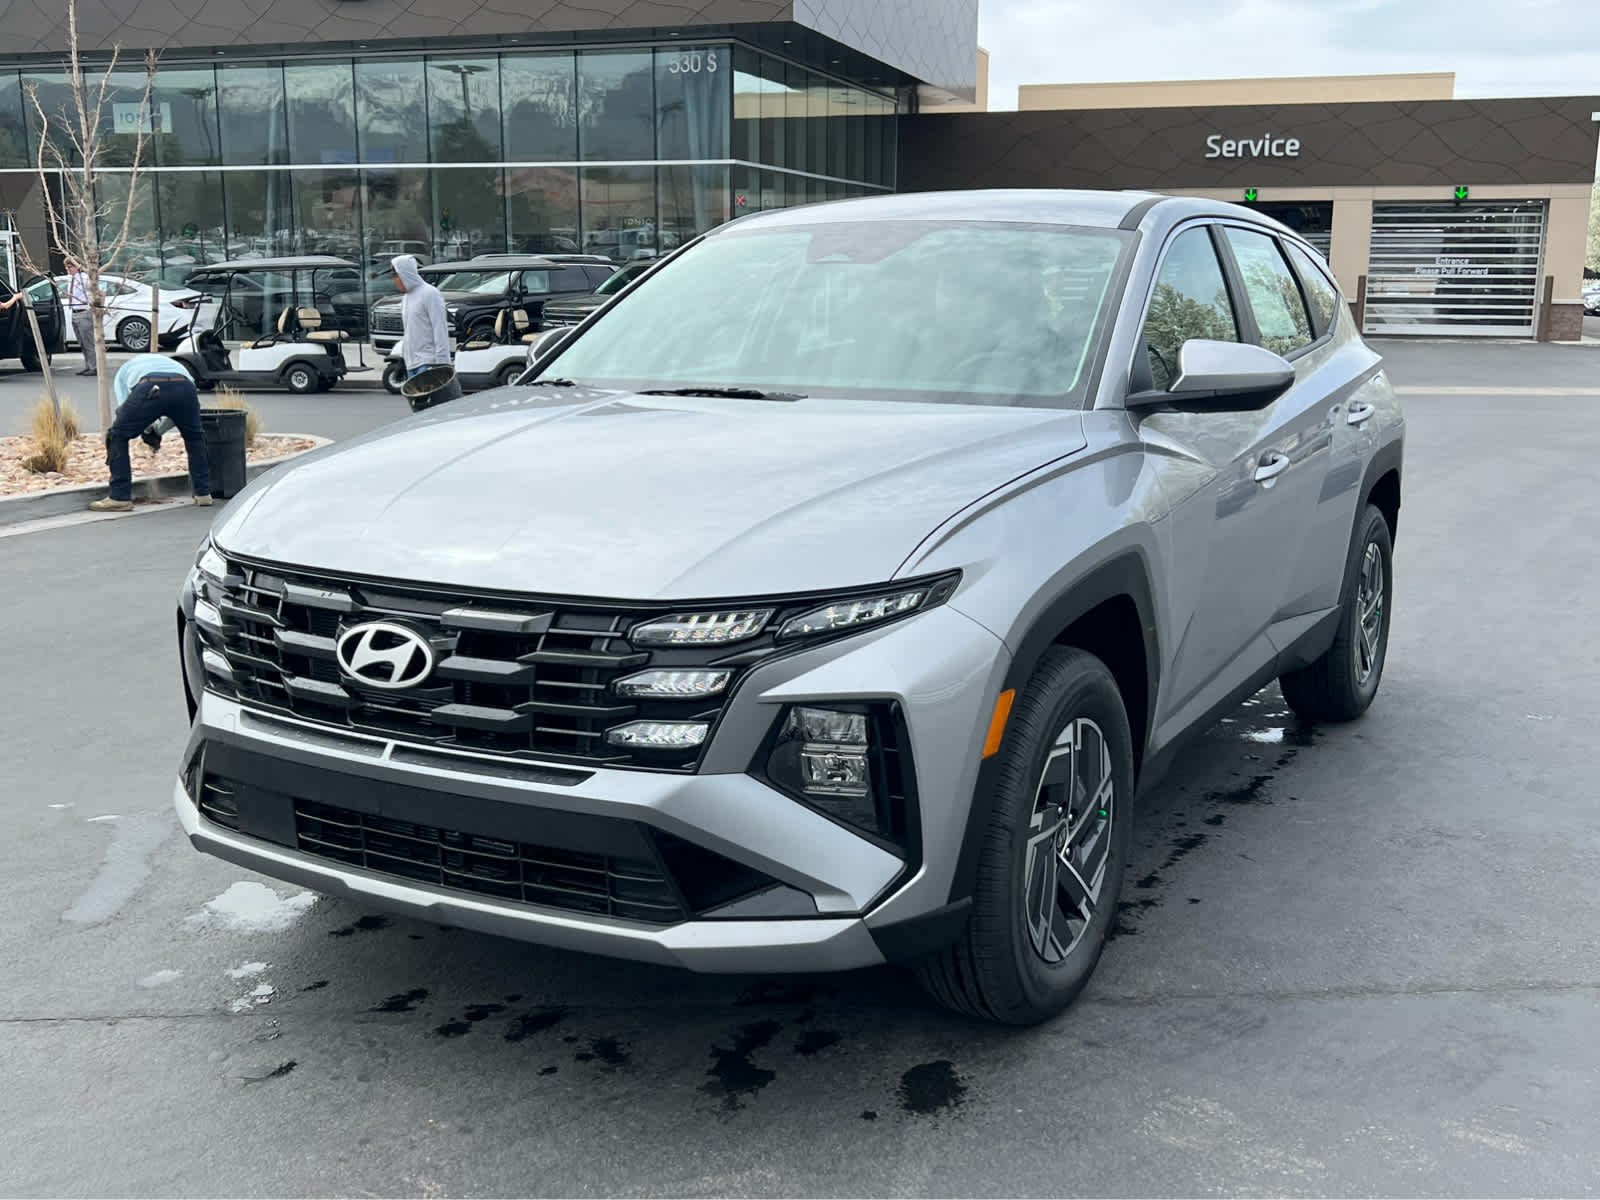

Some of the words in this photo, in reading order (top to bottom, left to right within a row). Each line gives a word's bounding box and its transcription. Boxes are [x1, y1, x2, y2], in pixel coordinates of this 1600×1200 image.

[669, 54, 701, 74] 530
[706, 53, 718, 73] S
[1205, 133, 1300, 158] Service
[1436, 257, 1469, 265] Entrance
[1415, 266, 1439, 275] Please
[1441, 266, 1455, 275] Pull
[1458, 265, 1488, 275] Forward
